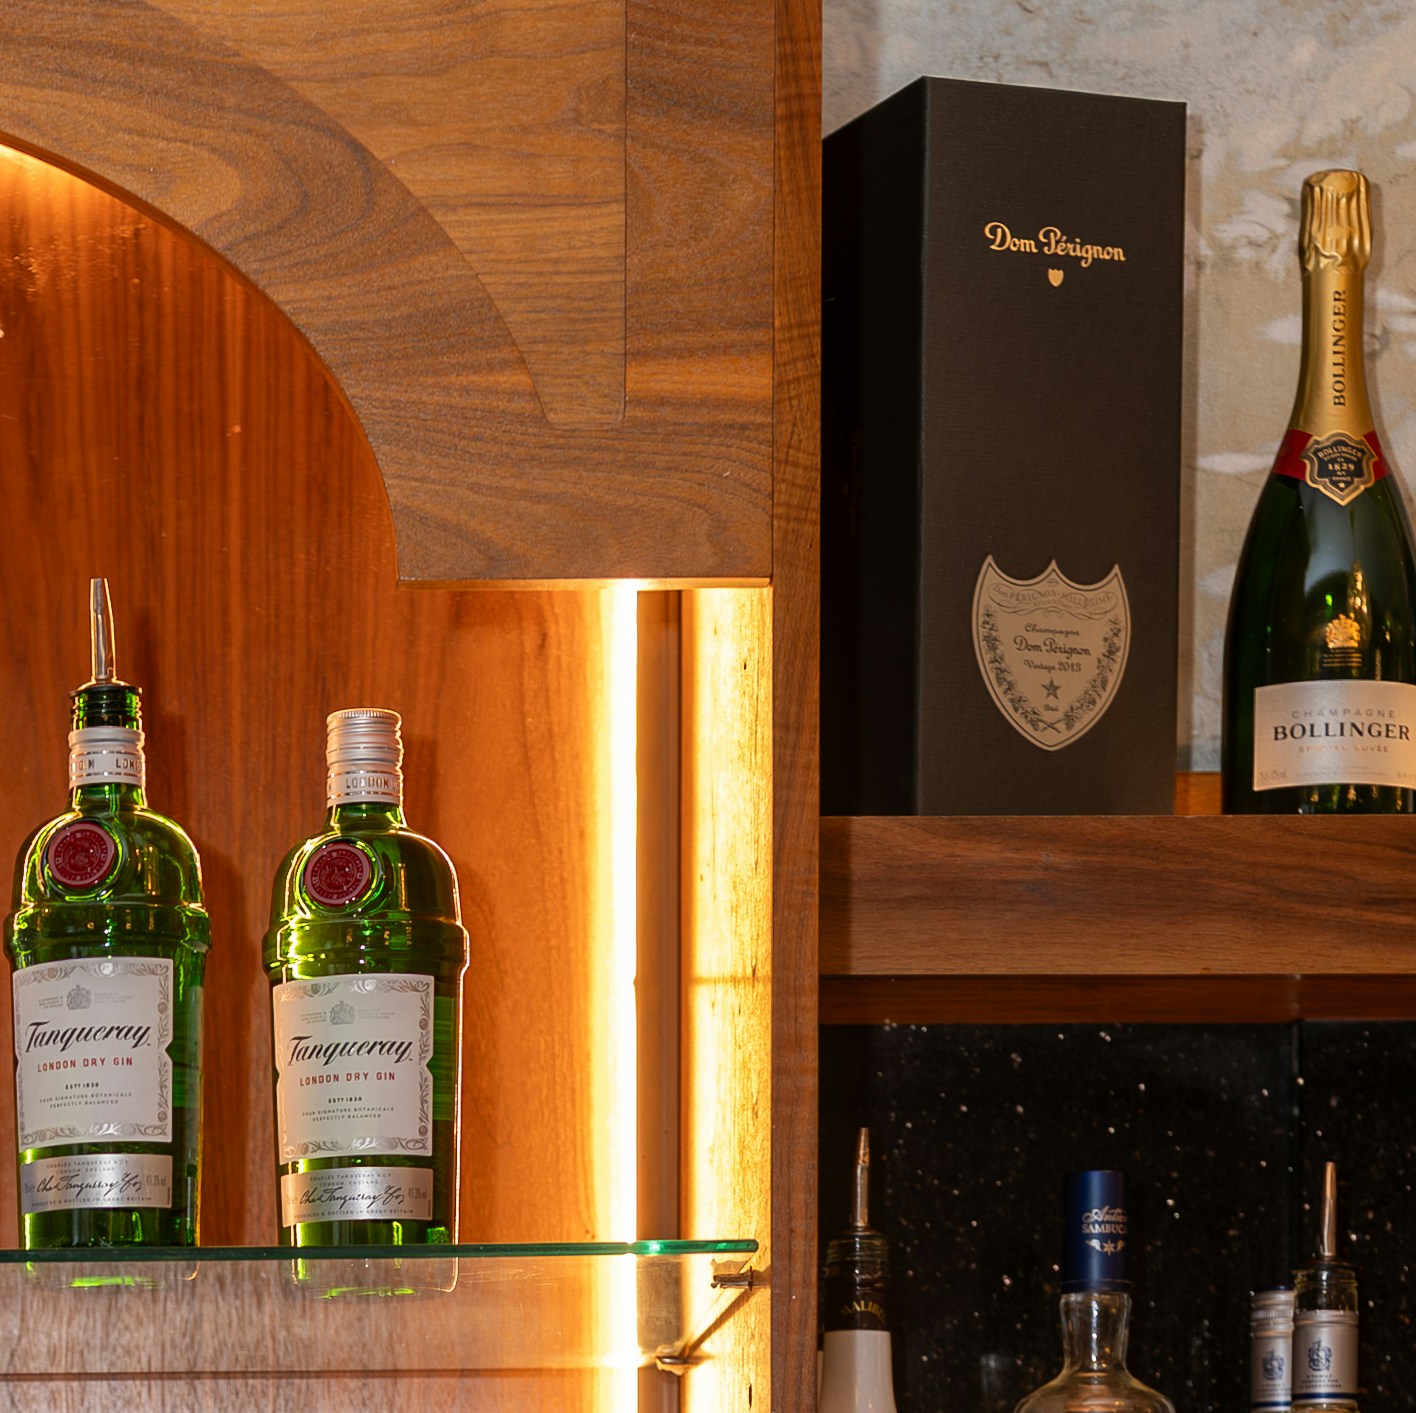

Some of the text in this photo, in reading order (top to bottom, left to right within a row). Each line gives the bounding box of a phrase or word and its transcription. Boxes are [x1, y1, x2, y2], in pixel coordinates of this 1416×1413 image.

[984, 221, 1126, 268] Dom Pérignon
[1332, 290, 1346, 407] BOLLINGER
[1317, 445, 1362, 459] BOLLINGER
[1328, 463, 1355, 472] 1829
[1025, 622, 1079, 638] Champagne
[1013, 635, 1091, 660] Dom Pérignon
[1024, 659, 1055, 673] Vintage
[1292, 708, 1395, 719] CHAMPAGNE
[1273, 722, 1410, 741] BOLLINGER
[25, 1020, 151, 1053] Tanqueray
[288, 1035, 413, 1067] Tanqueray
[37, 1057, 133, 1073] LONDON DRY GIN
[300, 1071, 396, 1087] LONDON DRY GIN
